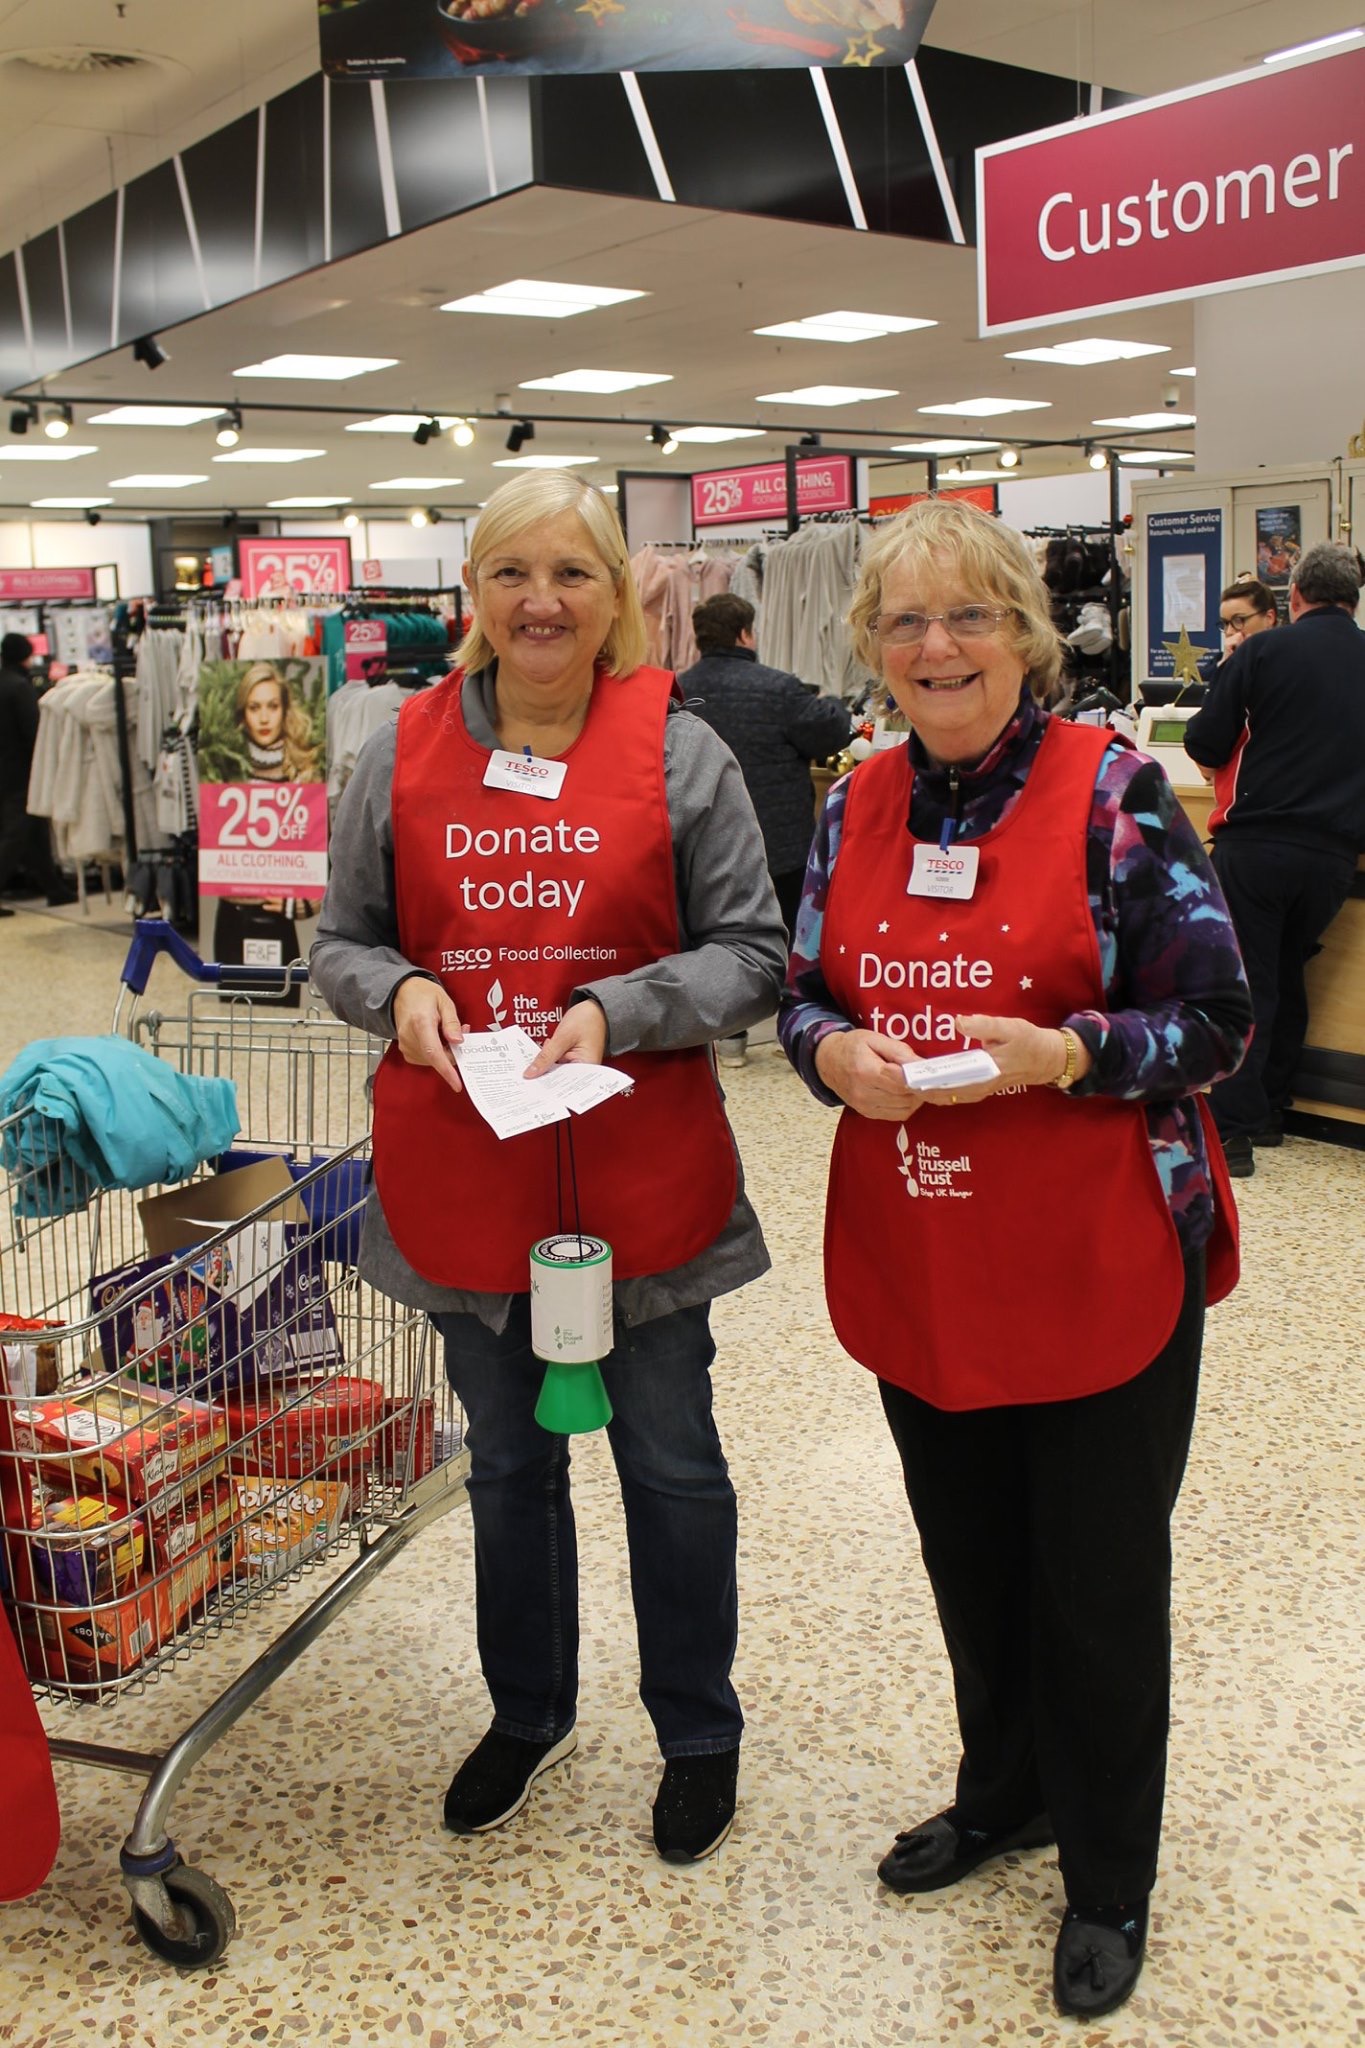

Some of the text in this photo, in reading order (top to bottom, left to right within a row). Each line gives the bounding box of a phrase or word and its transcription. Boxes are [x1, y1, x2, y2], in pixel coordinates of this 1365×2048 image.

[1038, 143, 1353, 262] Customer
[752, 472, 835, 494] ALL CLTHING,
[702, 479, 743, 515] 25%
[1148, 512, 1221, 527] Customer Service
[1173, 528, 1185, 536] help
[1198, 525, 1216, 533] advice
[256, 554, 337, 599] 25%
[350, 623, 381, 642] 25%
[505, 760, 549, 776] TESCO
[218, 787, 309, 848] 25%
[279, 824, 307, 841] OFF
[446, 819, 600, 859] Donate
[217, 853, 308, 870] ALL CLOTHING,
[927, 858, 965, 871] TESCO
[459, 870, 585, 917] today
[927, 884, 954, 895] VISITOR
[246, 942, 278, 962] F&F
[441, 945, 617, 966] TESCO Food Collection
[859, 952, 993, 989] Donate
[513, 993, 539, 1010] the
[514, 1006, 563, 1024] trussell
[916, 1141, 941, 1158] the
[917, 1155, 972, 1173] trussell
[919, 1170, 953, 1186] trust
[920, 1187, 935, 1199] Stop
[935, 1188, 948, 1198] UK
